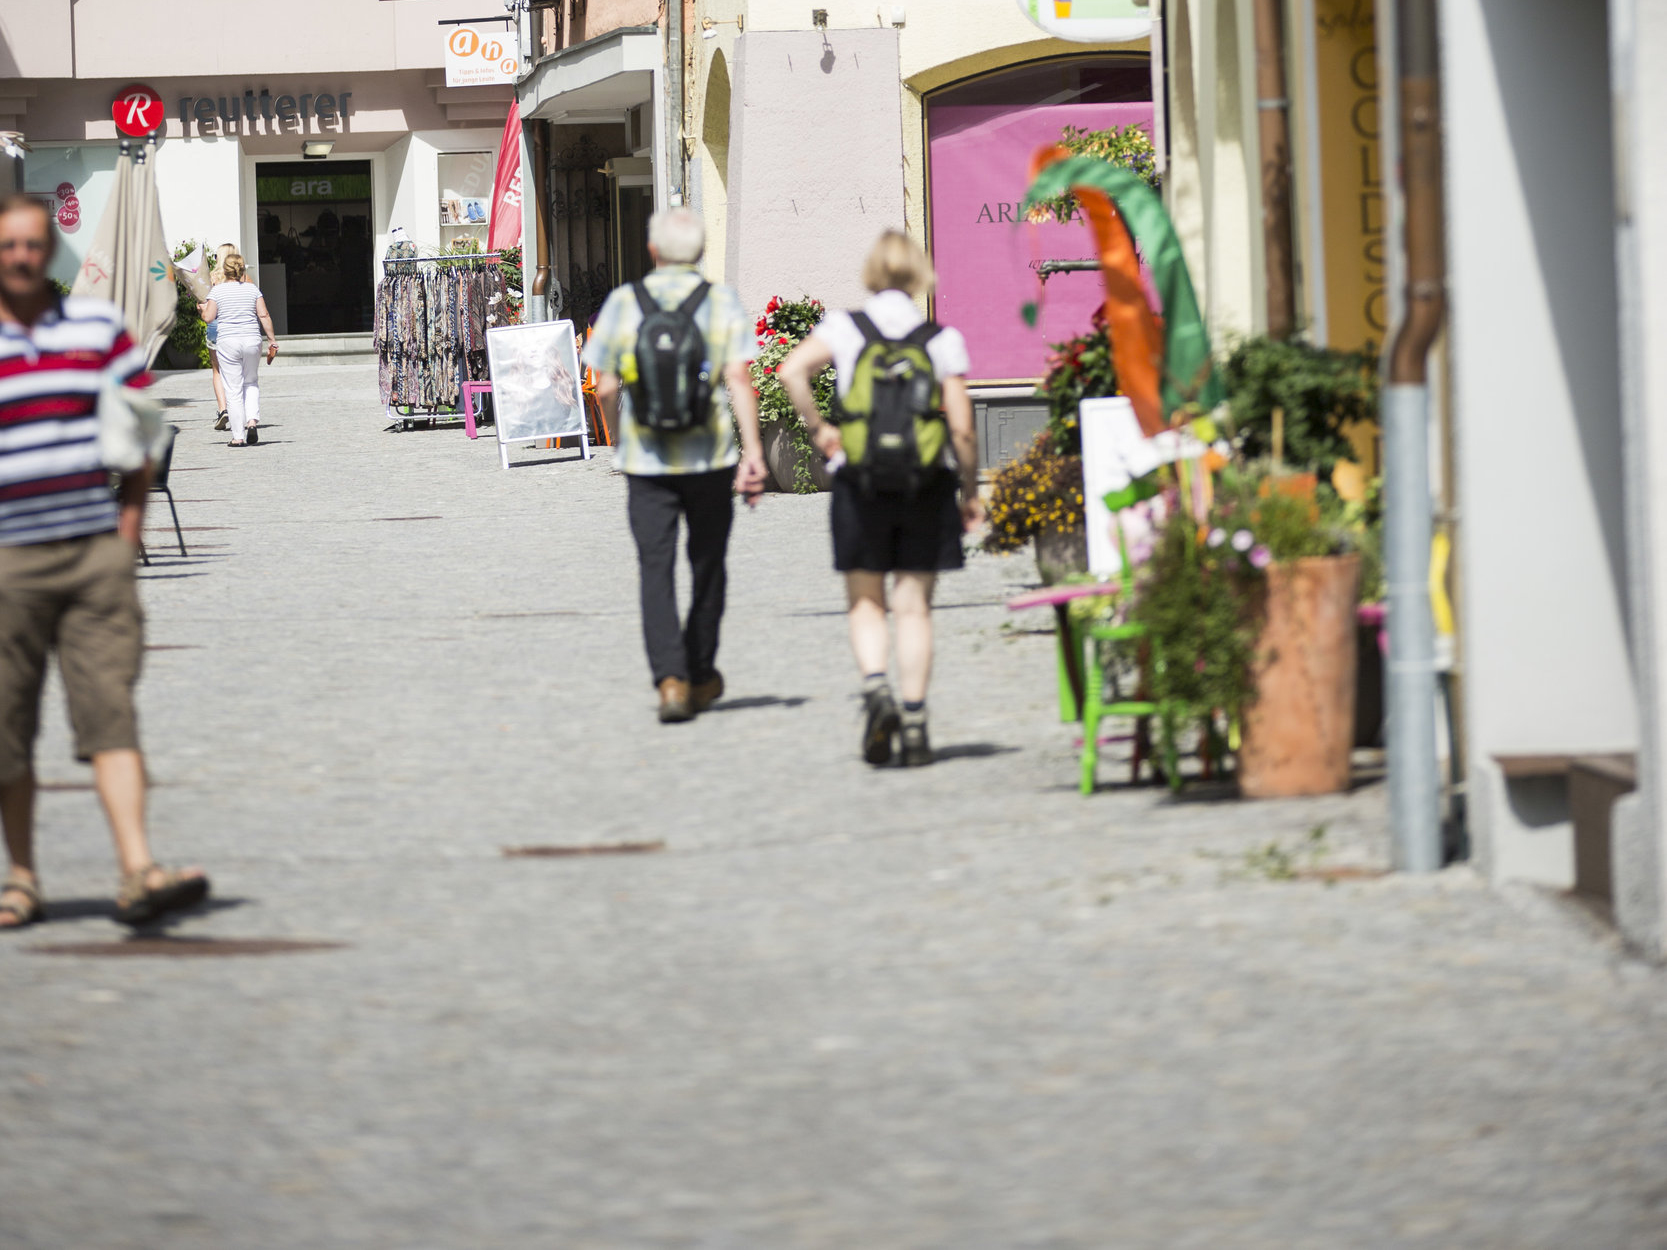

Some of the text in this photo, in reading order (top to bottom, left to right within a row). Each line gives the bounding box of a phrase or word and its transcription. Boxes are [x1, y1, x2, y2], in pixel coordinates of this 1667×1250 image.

[123, 93, 151, 128] R
[178, 89, 352, 123] reutterer
[290, 179, 333, 196] ara
[58, 212, 79, 221] -50%
